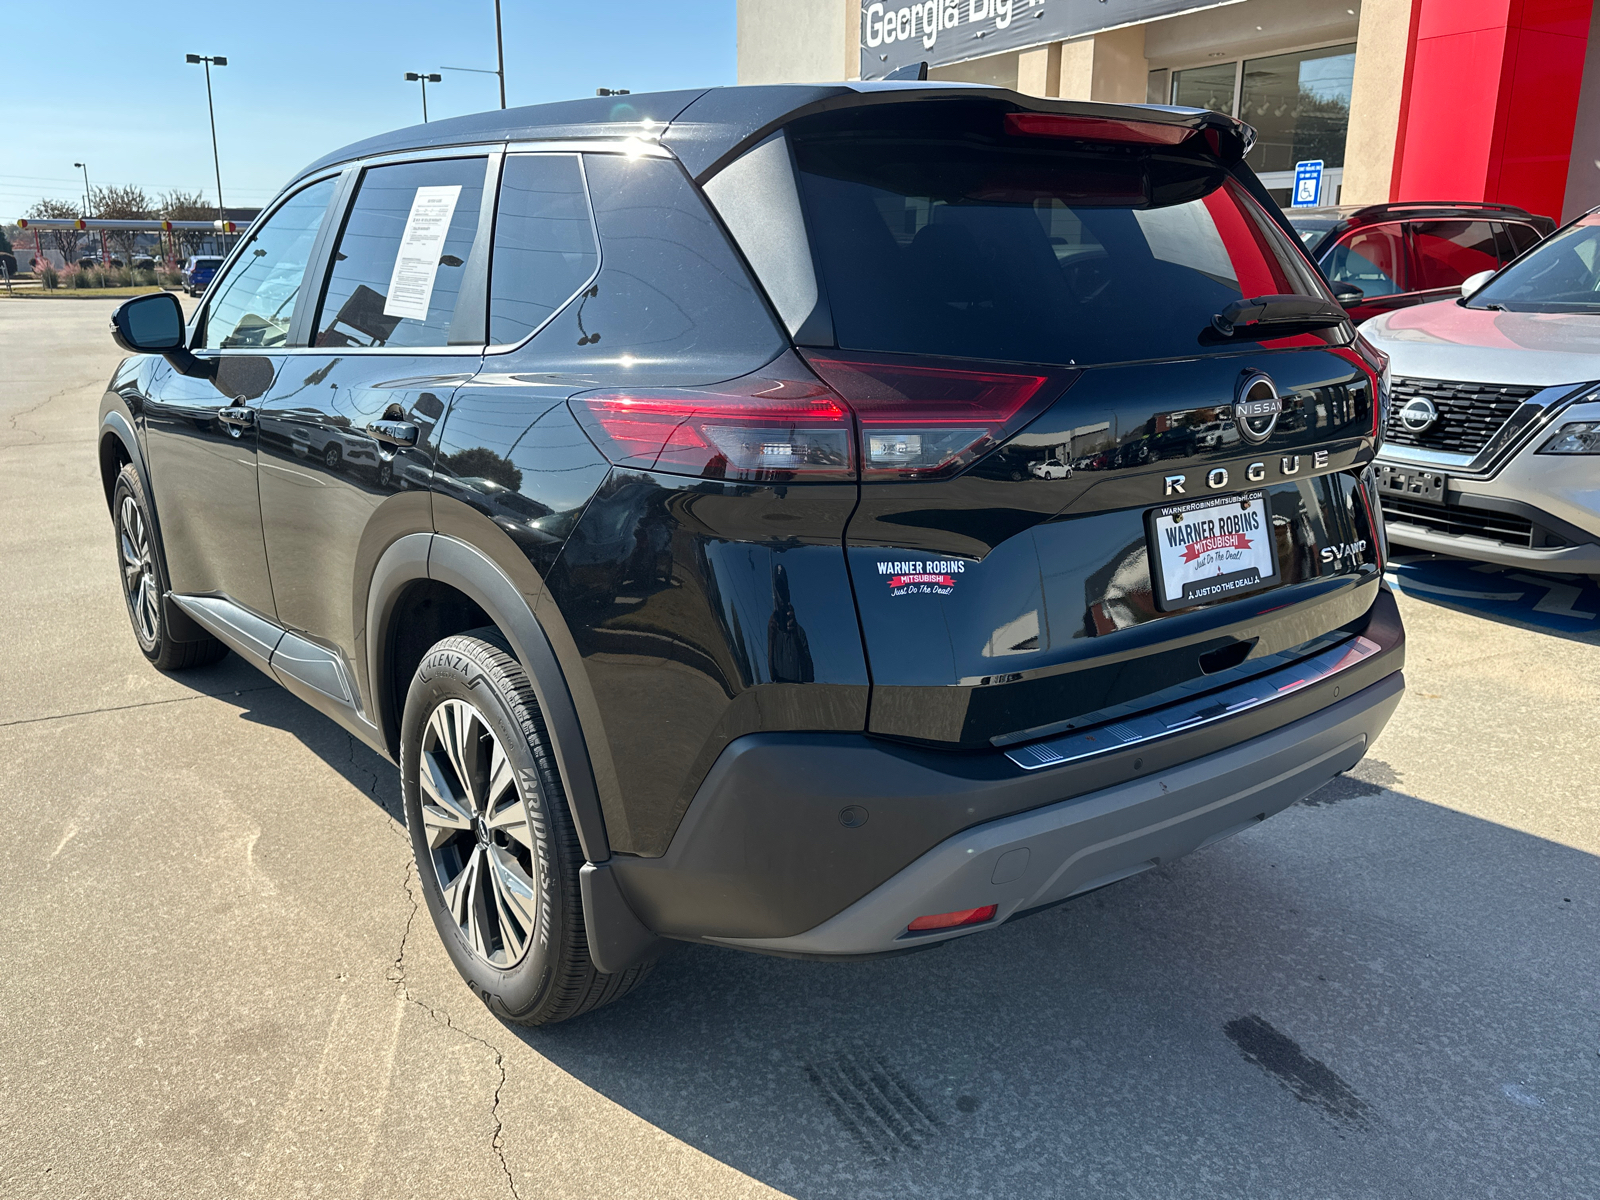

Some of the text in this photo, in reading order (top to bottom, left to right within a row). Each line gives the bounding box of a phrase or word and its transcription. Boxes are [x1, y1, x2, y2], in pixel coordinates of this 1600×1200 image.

[866, 0, 960, 48] Georgia
[1238, 401, 1282, 415] NISSAN
[1164, 449, 1330, 496] ROGUE
[1165, 511, 1260, 547] WARNER ROBINS
[1194, 535, 1239, 555] MITSUBISHI
[1320, 540, 1367, 563] SV AWD
[876, 560, 965, 575] WARNER ROBINS
[1194, 550, 1243, 571] Just Do The Deal!
[900, 574, 944, 583] MITSUBISHI
[1194, 577, 1254, 598] JUST DO THE DEAL!
[890, 584, 953, 597] Just Do The Deal!
[425, 654, 470, 675] ALENZA
